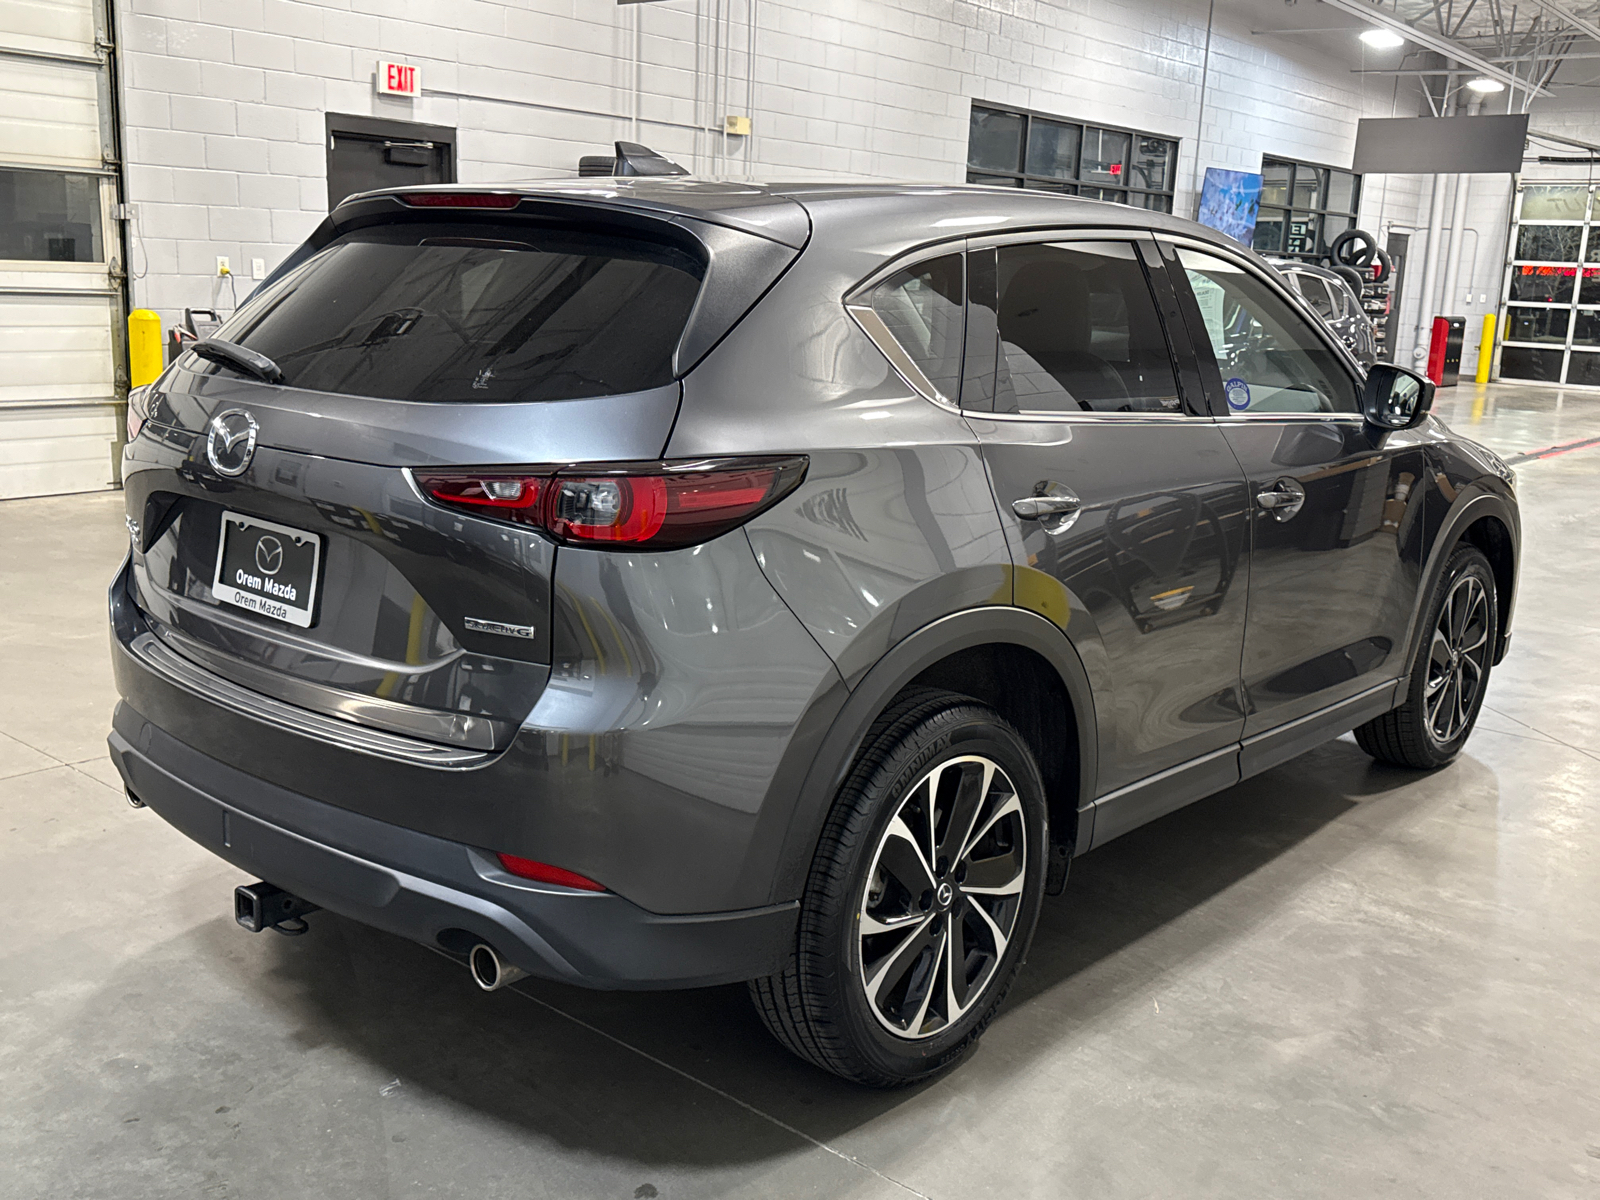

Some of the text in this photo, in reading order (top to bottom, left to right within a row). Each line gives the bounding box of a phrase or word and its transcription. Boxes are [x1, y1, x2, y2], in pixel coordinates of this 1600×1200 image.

[388, 64, 415, 93] EXIT
[236, 568, 297, 601] Orem Mazda
[234, 591, 287, 619] Orem Mazda
[892, 731, 952, 799] OMNIMAX
